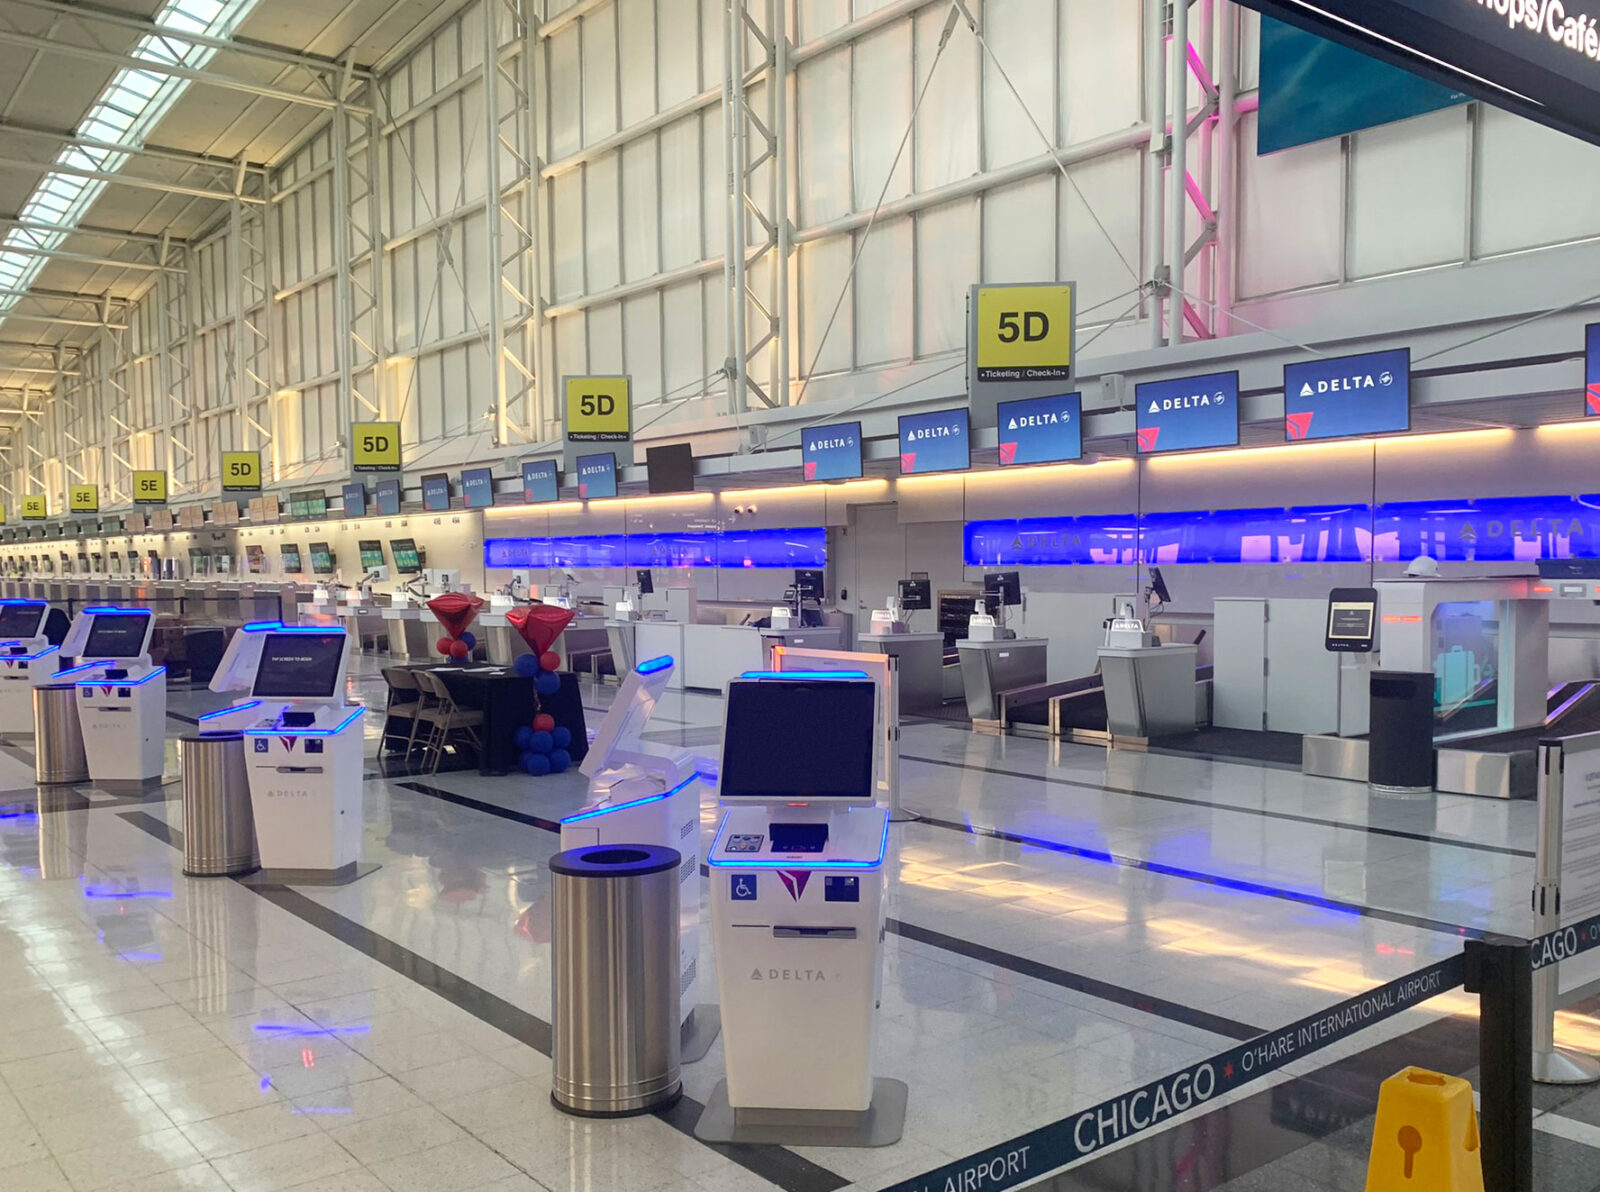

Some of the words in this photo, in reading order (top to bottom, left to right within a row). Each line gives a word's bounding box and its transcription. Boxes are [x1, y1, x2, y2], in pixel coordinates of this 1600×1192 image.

[998, 312, 1050, 343] 5D
[985, 370, 1020, 379] Ticketing
[1317, 375, 1375, 393] DELTA
[580, 394, 615, 416] 5D
[1163, 394, 1210, 411] DELTA
[1020, 413, 1058, 428] DELTA
[917, 426, 950, 439] DELTA
[363, 436, 389, 453] 5D
[817, 438, 846, 450] DELTA
[230, 463, 252, 476] 5D
[531, 471, 548, 480] DELTA
[587, 465, 606, 475] DELTA
[141, 480, 158, 491] 5E
[76, 492, 90, 503] 5E
[26, 501, 40, 511] 5E
[1487, 518, 1584, 537] DELTA
[1028, 534, 1082, 548] DELTA
[276, 790, 308, 798] DELTA
[768, 968, 826, 981] DELTA
[1073, 1063, 1216, 1153] CHICAGO
[1241, 1032, 1296, 1072] O'HARE
[1298, 990, 1395, 1048] INTERNATIONAL
[1397, 969, 1443, 1003] AIRPORT
[943, 1145, 1031, 1192] AIRPORT
